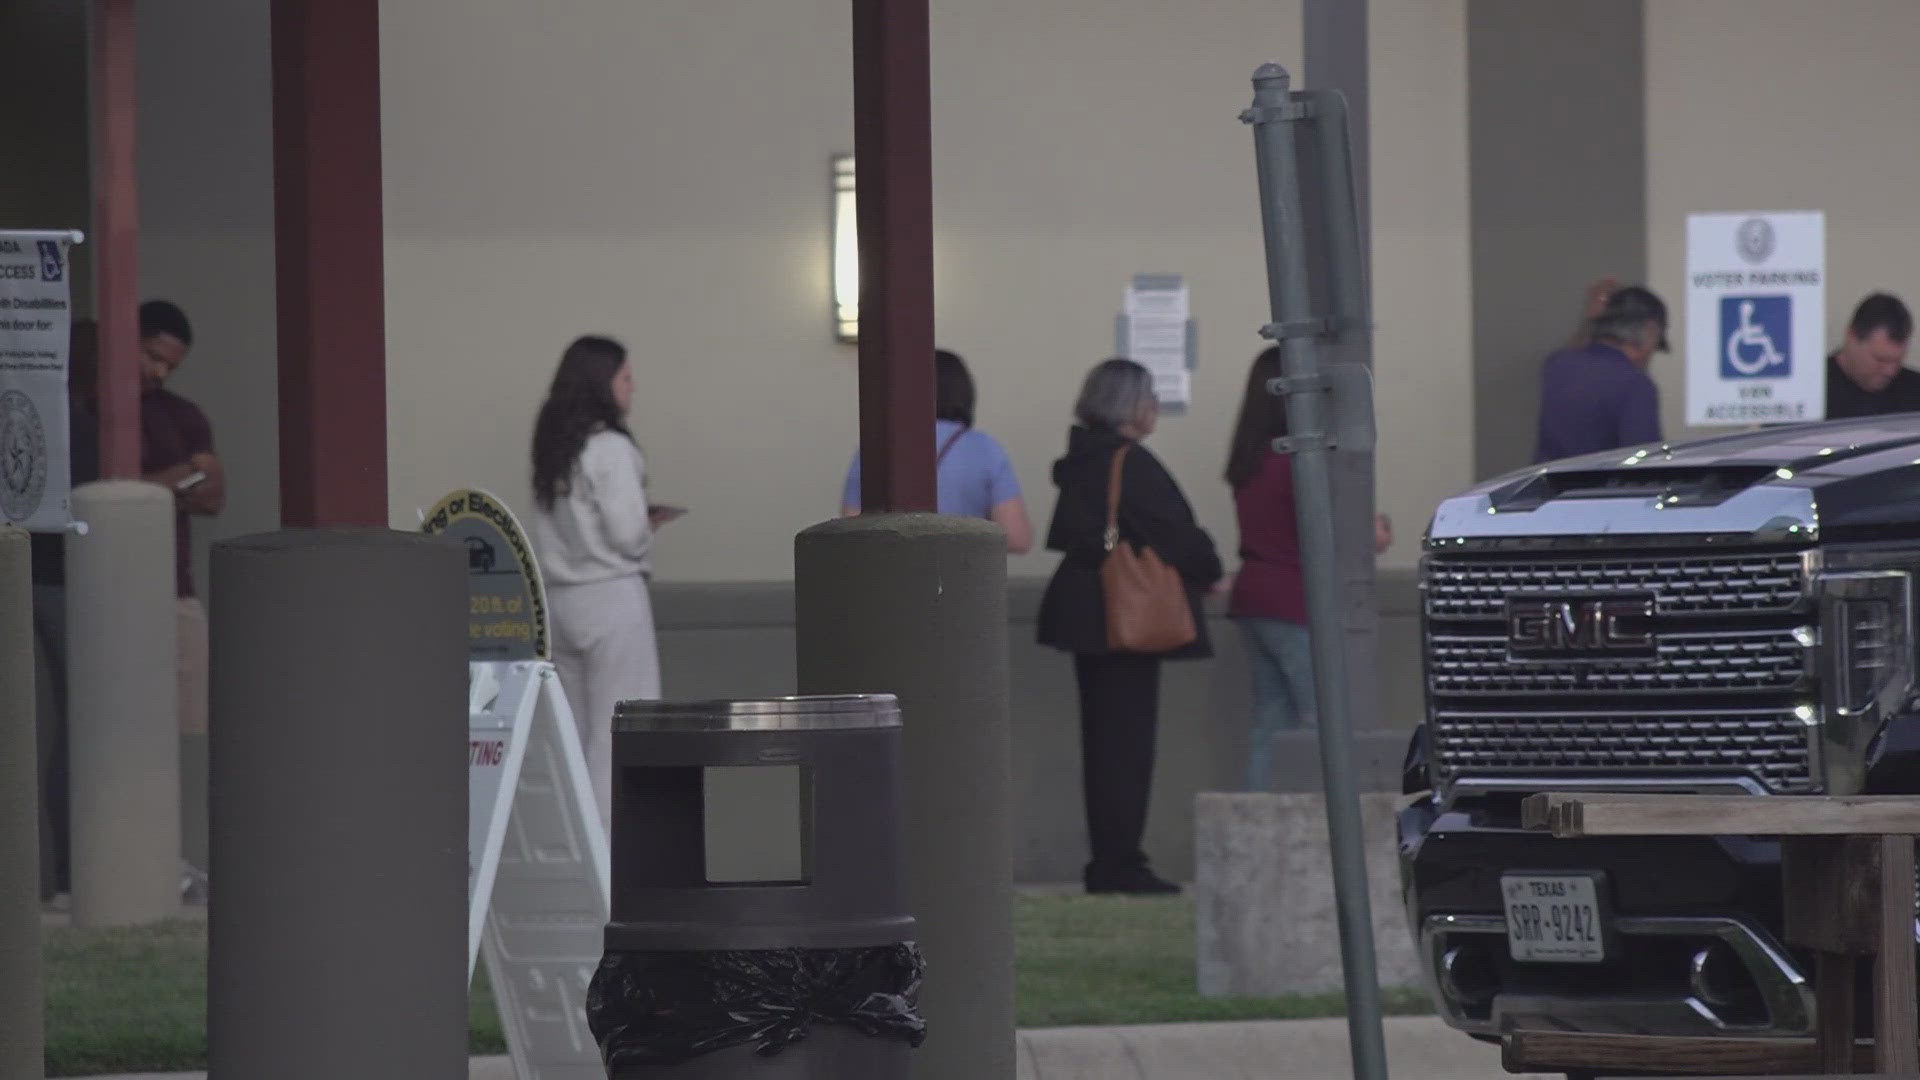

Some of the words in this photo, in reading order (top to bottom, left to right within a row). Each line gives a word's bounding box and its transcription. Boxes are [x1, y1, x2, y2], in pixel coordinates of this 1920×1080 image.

[1750, 271, 1820, 286] PARKING
[14, 319, 35, 330] door
[1706, 403, 1806, 419] ACCESSIBLE
[449, 498, 465, 515] or
[507, 596, 523, 613] of
[485, 620, 531, 642] voting
[1510, 601, 1653, 649] GMC
[1529, 881, 1567, 897] TEXAS
